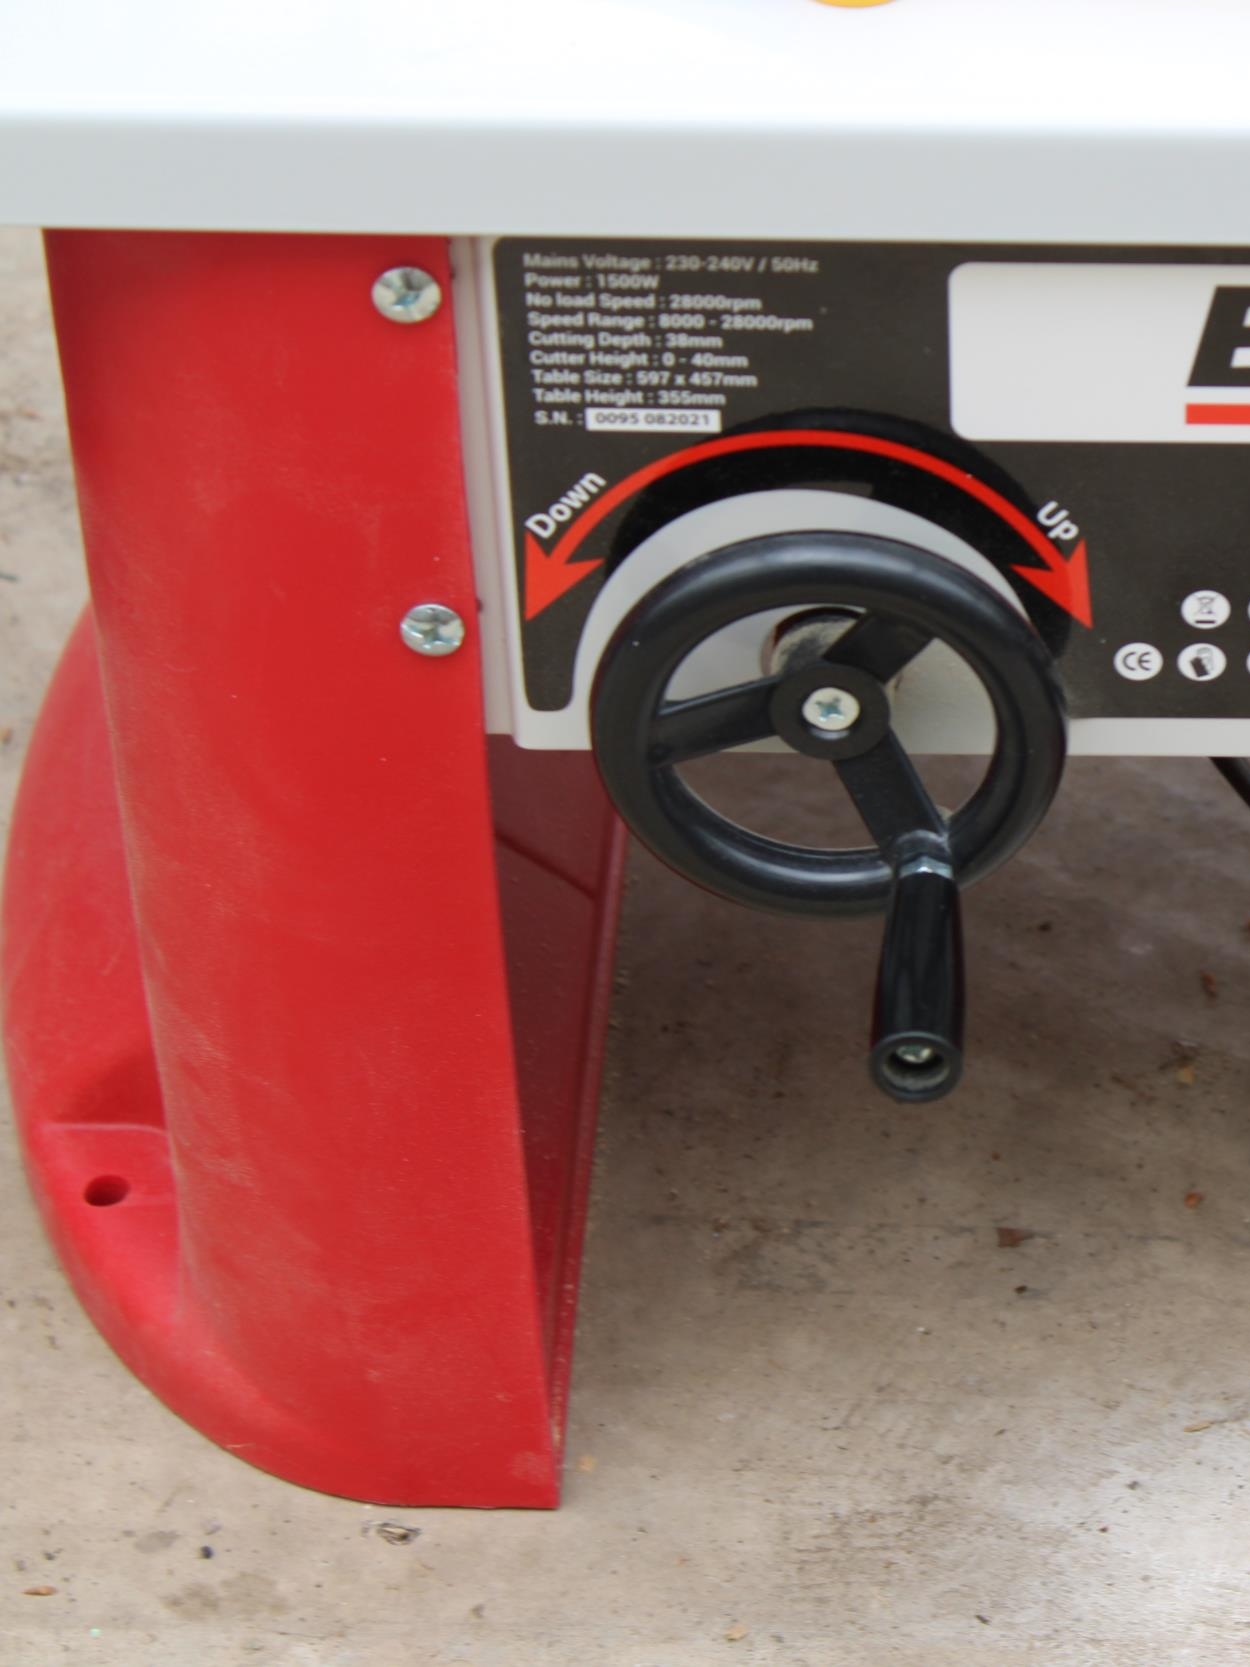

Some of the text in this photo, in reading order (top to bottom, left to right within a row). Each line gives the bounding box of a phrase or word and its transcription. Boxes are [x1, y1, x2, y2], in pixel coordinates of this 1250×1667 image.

[522, 254, 578, 268] Mains
[583, 254, 651, 272] Voltage
[665, 256, 753, 272] 230-240V
[770, 257, 819, 273] 50Hz
[524, 272, 581, 288] Power
[597, 273, 659, 289] 1500W
[525, 292, 553, 307] No
[556, 292, 596, 308] load
[599, 294, 656, 311] Speed
[669, 294, 763, 313] 28000rpm
[527, 311, 583, 330] Speed
[588, 313, 644, 330] Range
[658, 314, 705, 329] 8000
[721, 315, 813, 333] 28000rpm
[528, 332, 595, 349] Cutting
[598, 332, 651, 350] Depth
[665, 333, 723, 349] 38mm
[529, 351, 586, 366] Cutter
[589, 352, 649, 369] Height
[662, 353, 674, 367] 0
[691, 353, 748, 369] 40mm
[531, 369, 579, 384] Table
[583, 370, 622, 385] Size
[636, 371, 670, 386] 597
[689, 372, 758, 388] 457mm
[532, 388, 581, 404] Table
[585, 388, 643, 407] Height
[658, 390, 726, 406] 355mm
[534, 410, 573, 425] S.N.
[595, 413, 639, 425] 0095
[644, 414, 711, 426] 082021
[524, 470, 608, 540] Down
[1035, 500, 1080, 543] Up
